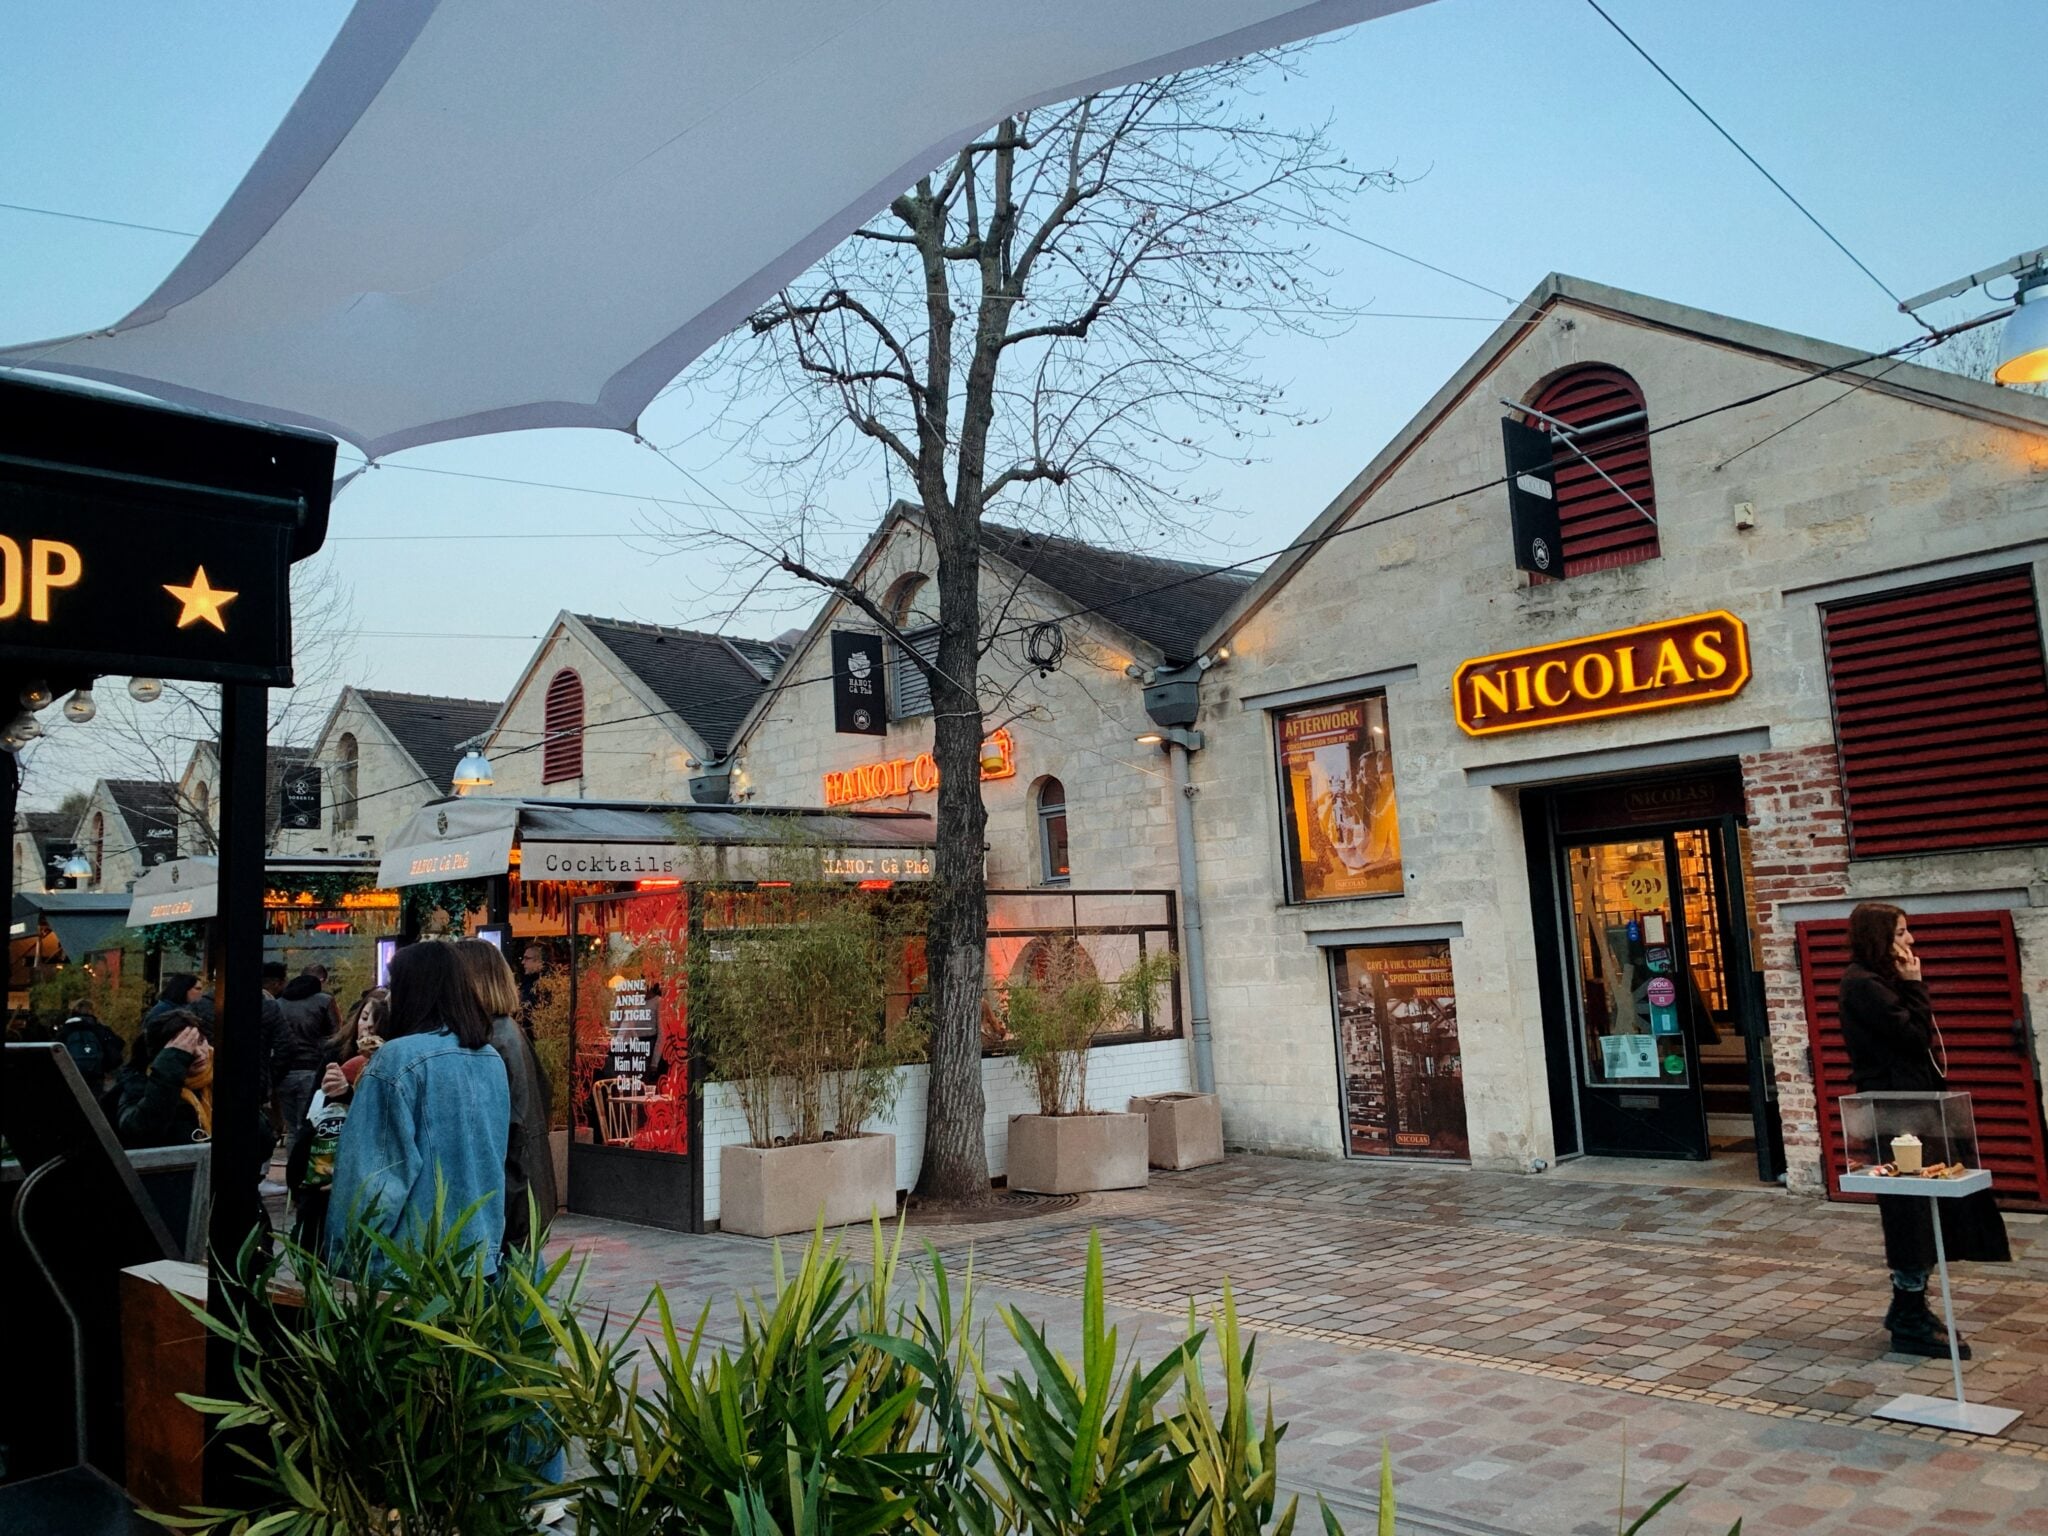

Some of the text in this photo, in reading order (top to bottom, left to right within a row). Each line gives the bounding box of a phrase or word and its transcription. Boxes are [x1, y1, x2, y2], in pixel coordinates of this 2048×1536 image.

[1470, 631, 1727, 719] NICOLAS
[1285, 710, 1359, 737] AFTERWORK
[822, 759, 904, 806] HANOI
[546, 855, 673, 872] Cocktails
[904, 858, 930, 874] Phê
[1366, 961, 1383, 970] CAVE
[615, 979, 646, 991] BONNE
[615, 992, 647, 1007] ANNÉE
[610, 1009, 651, 1021] DU TIGRE
[1398, 1136, 1428, 1144] NICOLAS
